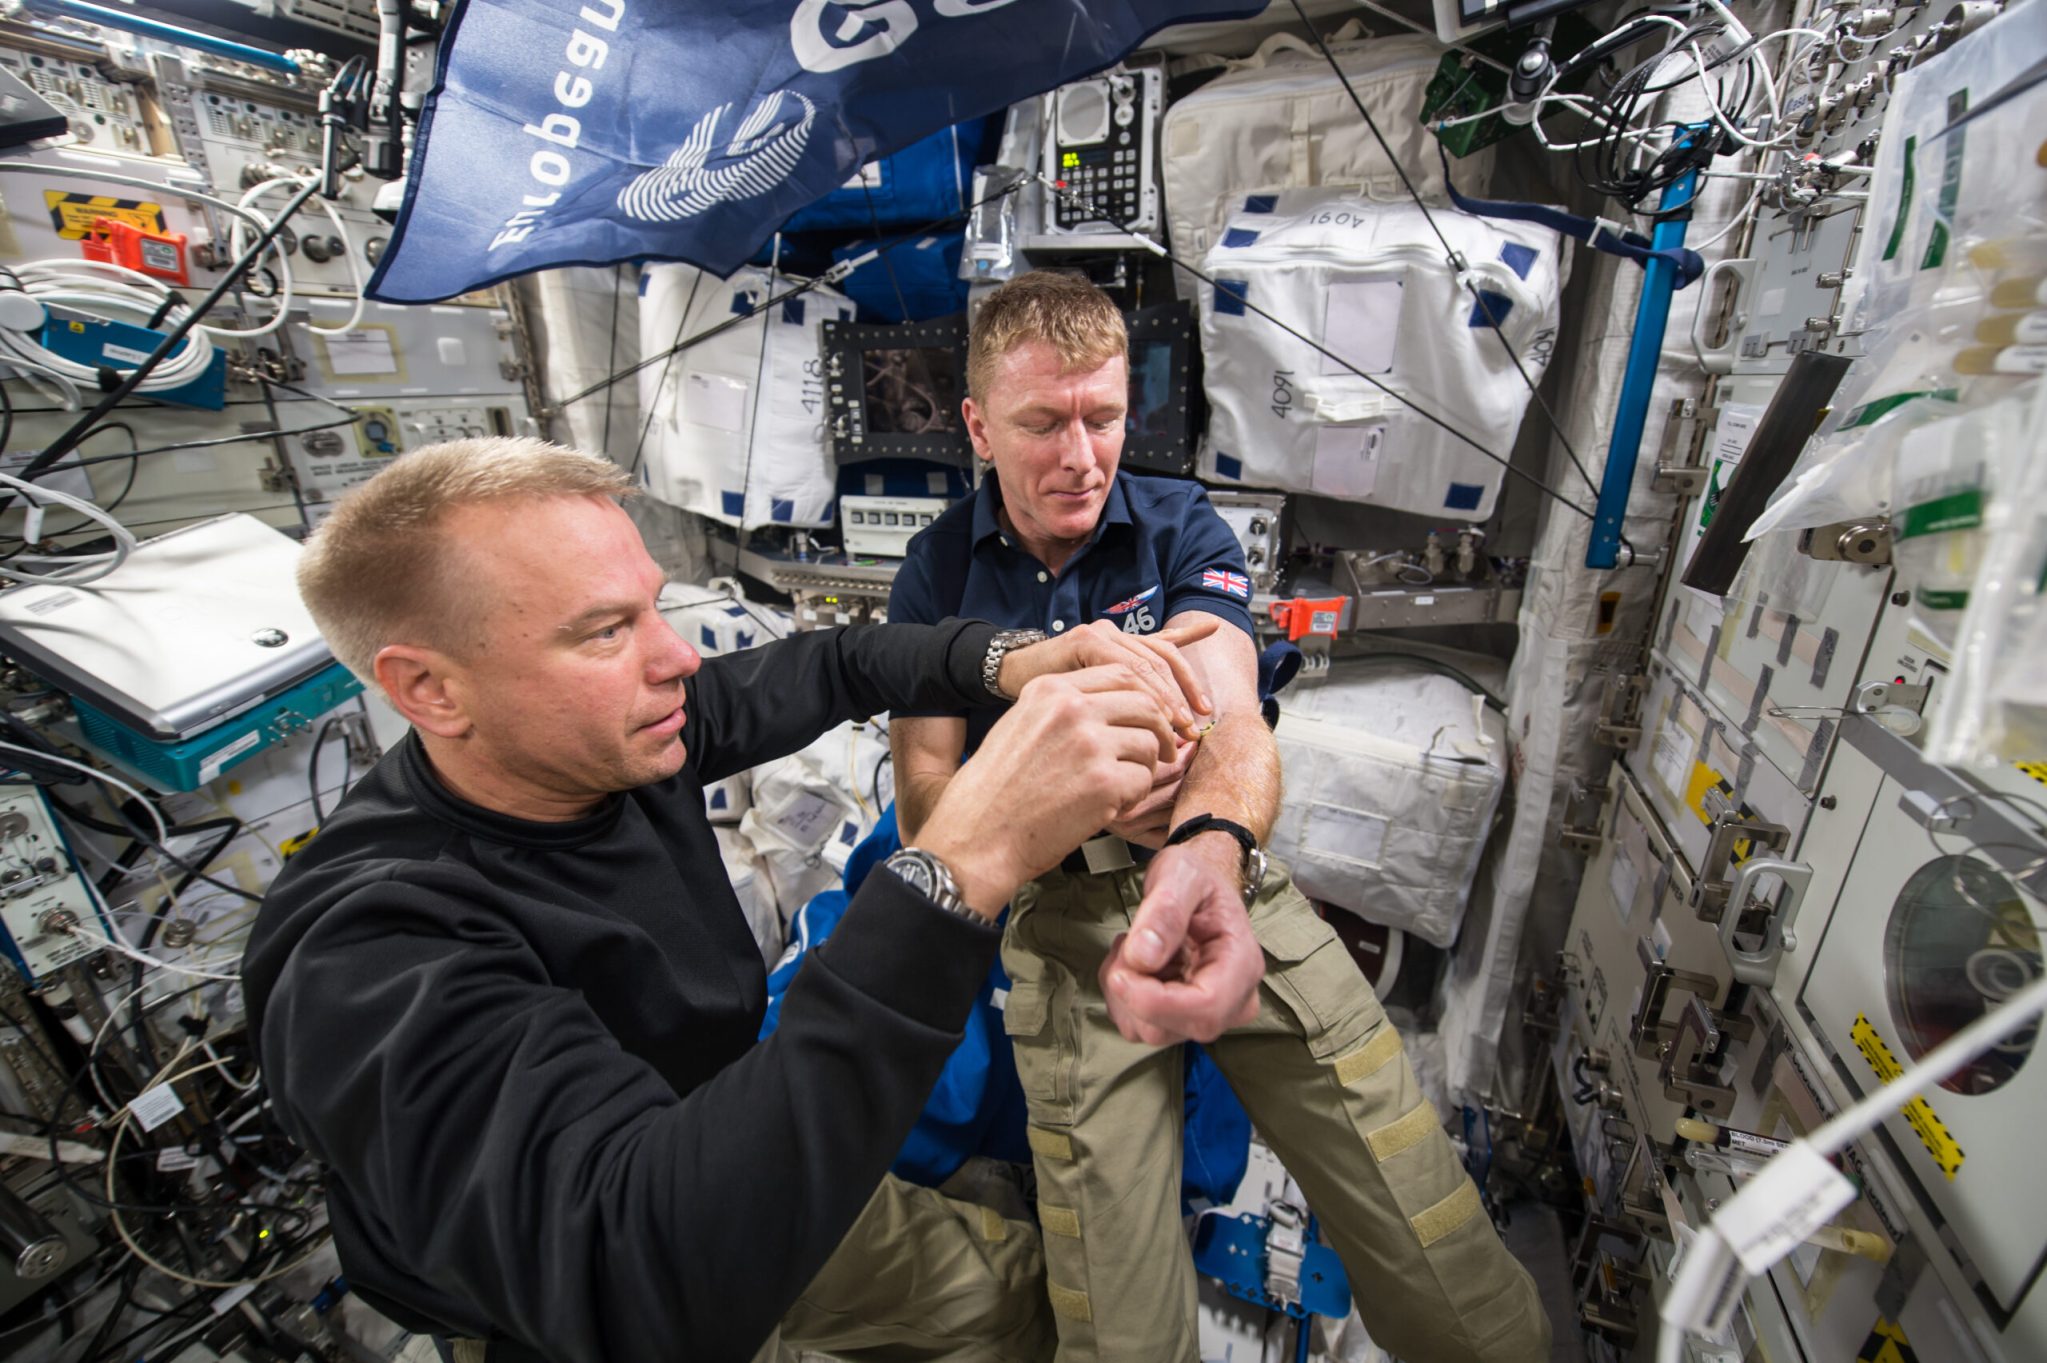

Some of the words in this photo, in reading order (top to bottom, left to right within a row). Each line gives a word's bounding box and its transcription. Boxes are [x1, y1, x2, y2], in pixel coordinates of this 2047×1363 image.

[1310, 211, 1365, 229] 4091
[801, 358, 823, 414] 4118
[1270, 370, 1295, 420] 4091
[1122, 605, 1156, 635] 46
